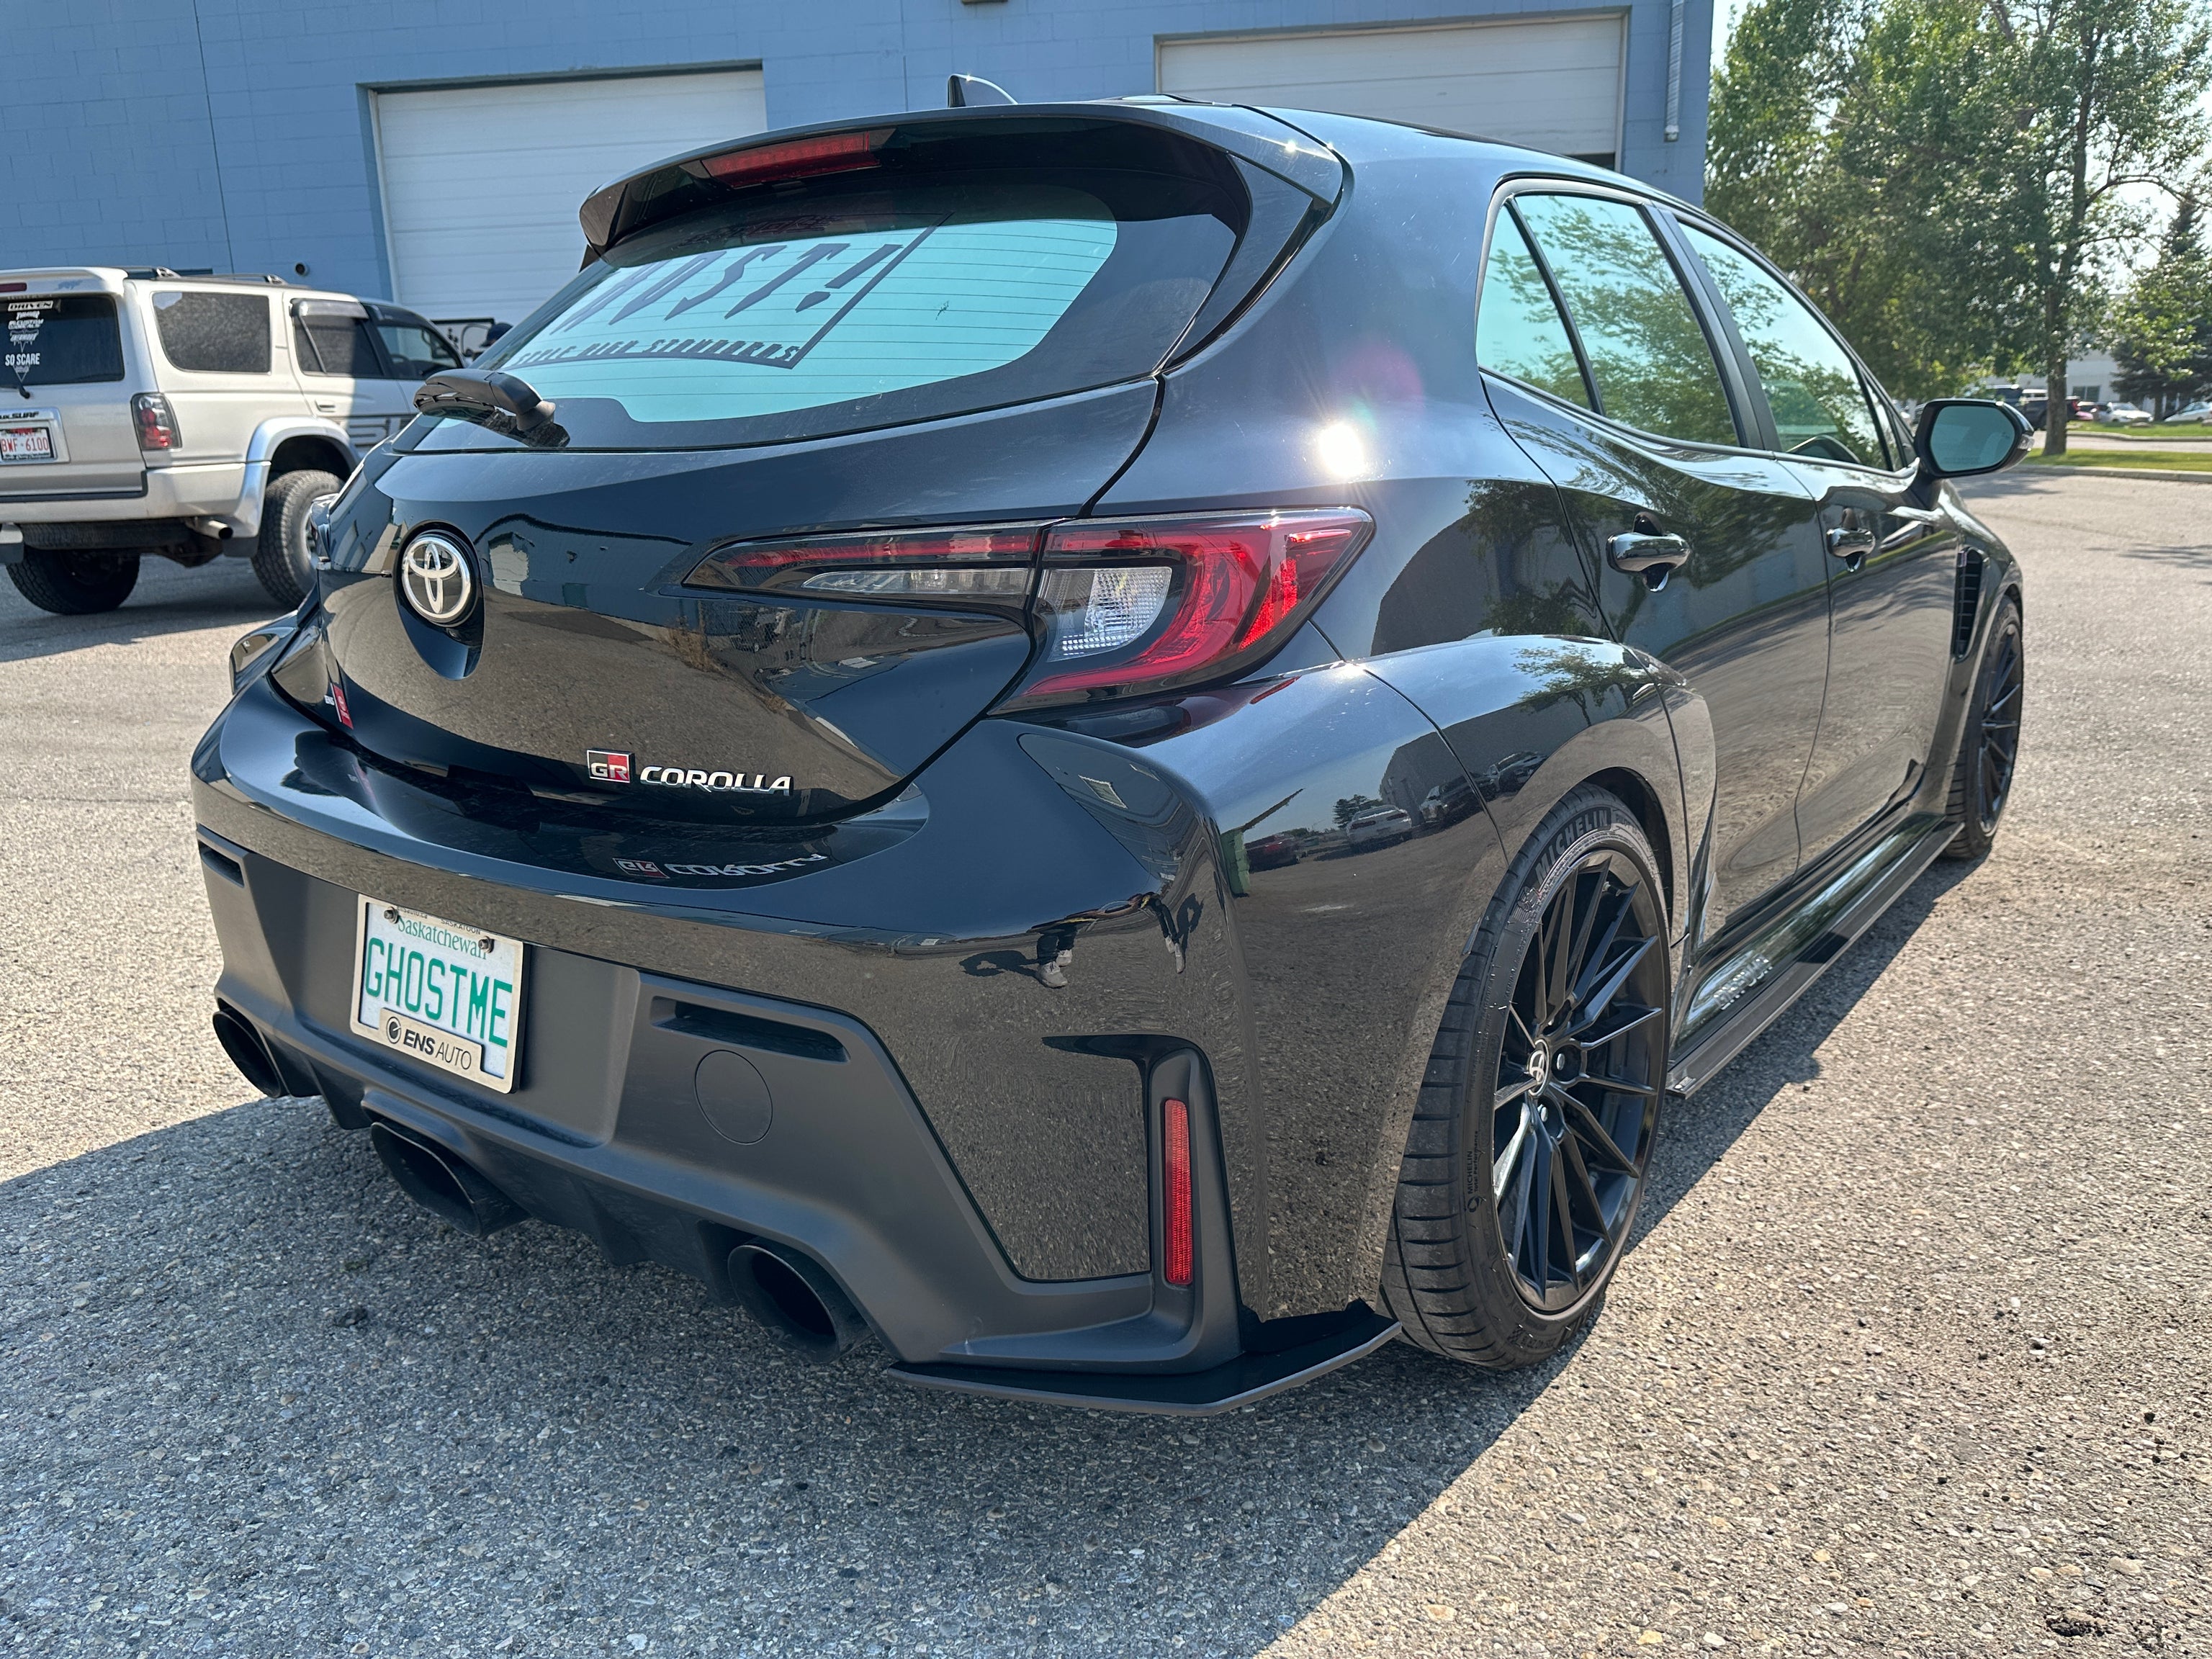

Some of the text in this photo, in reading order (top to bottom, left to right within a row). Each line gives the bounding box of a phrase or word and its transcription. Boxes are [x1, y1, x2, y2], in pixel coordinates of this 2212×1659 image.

[5, 352, 40, 366] SO SCARE
[590, 762, 793, 796] GR COROLLA
[1534, 809, 1608, 886] MICHELIN
[397, 914, 487, 961] Saskatchewan
[439, 917, 482, 935] SASKATOON
[365, 938, 513, 1048] GHOSTME
[403, 1028, 472, 1070] ENS AUTO
